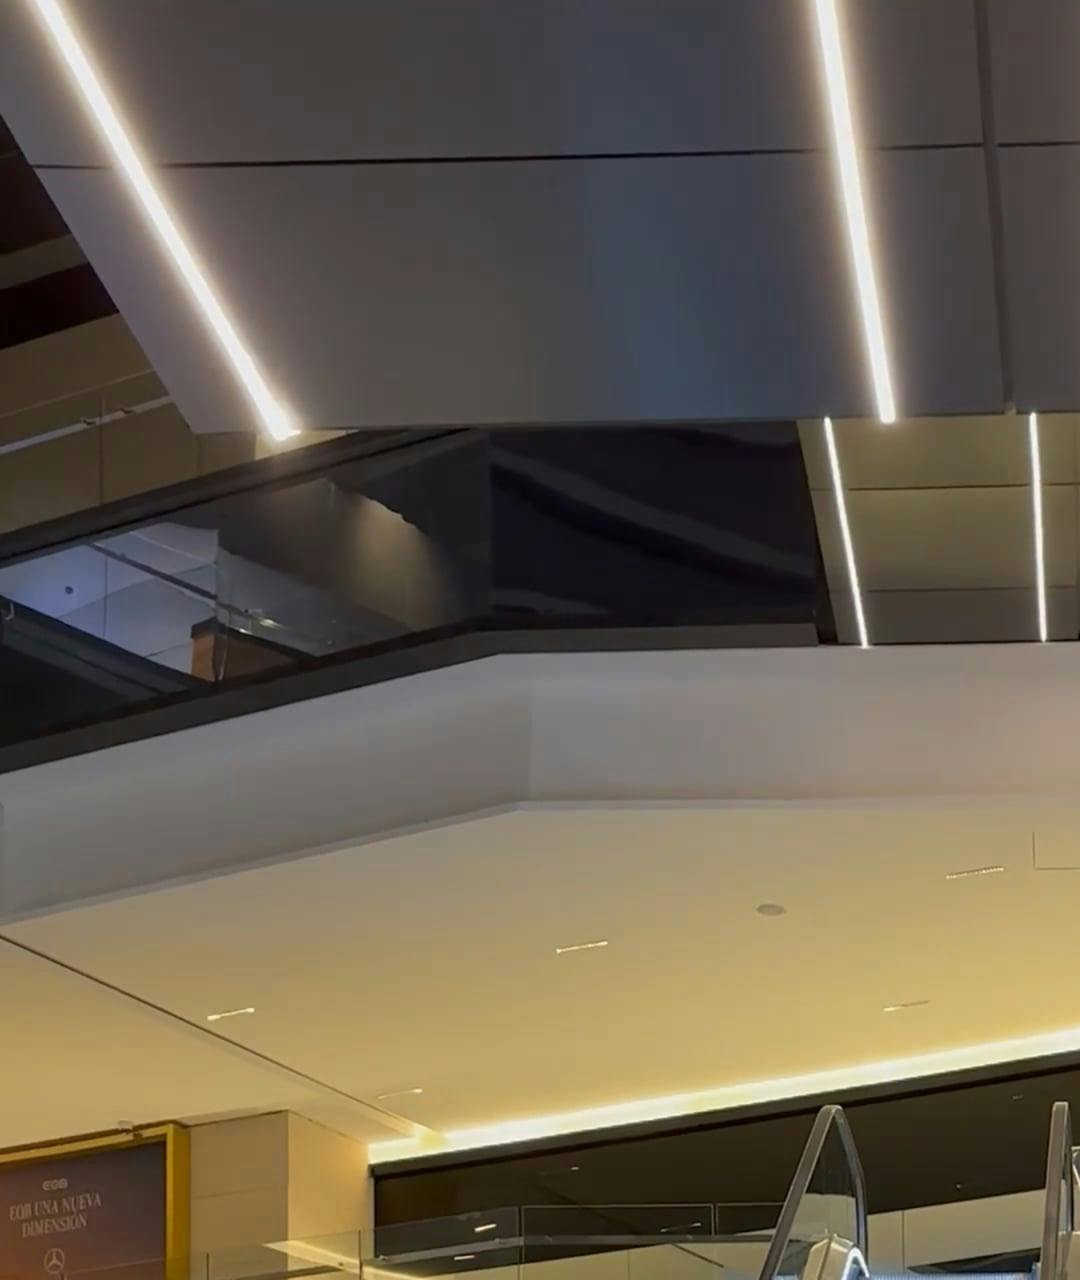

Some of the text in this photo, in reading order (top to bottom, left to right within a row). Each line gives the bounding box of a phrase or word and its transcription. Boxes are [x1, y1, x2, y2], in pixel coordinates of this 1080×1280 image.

[34, 1200, 59, 1216] UNA
[63, 1192, 101, 1213] NUEVA
[22, 1211, 87, 1237] DIMENSIÓN
